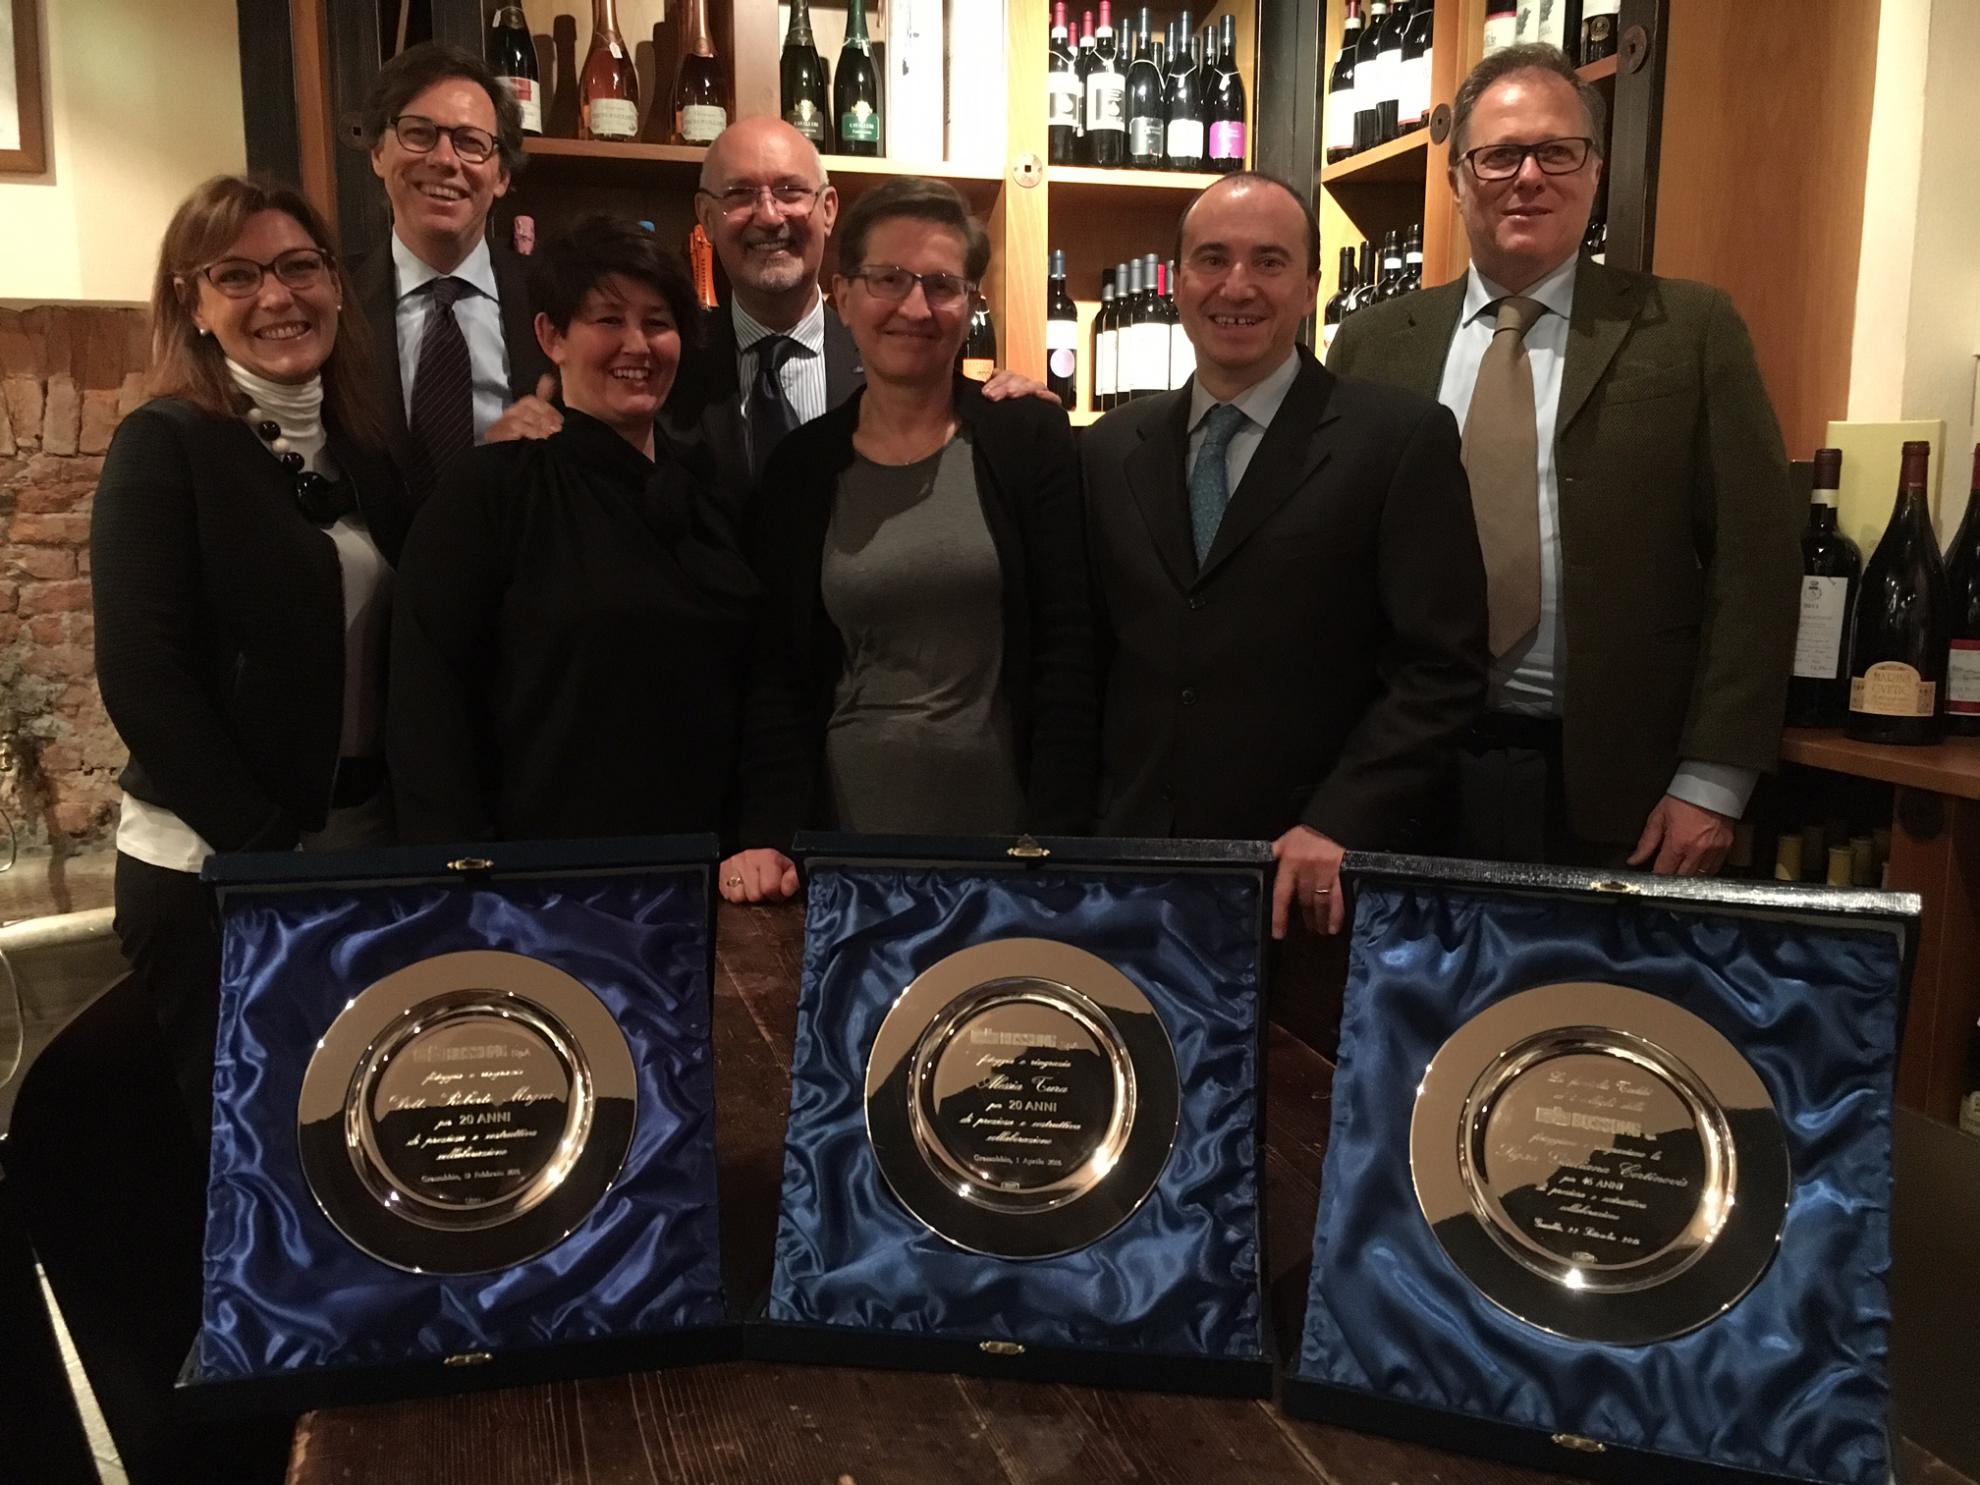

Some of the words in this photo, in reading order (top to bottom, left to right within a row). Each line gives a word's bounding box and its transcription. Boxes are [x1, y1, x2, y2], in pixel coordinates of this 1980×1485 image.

[1008, 1100, 1022, 1111] 20
[1025, 1102, 1057, 1113] ANNI
[459, 1114, 474, 1125] 20
[477, 1112, 511, 1124] ANNI
[1595, 1179, 1625, 1192] ANNI
